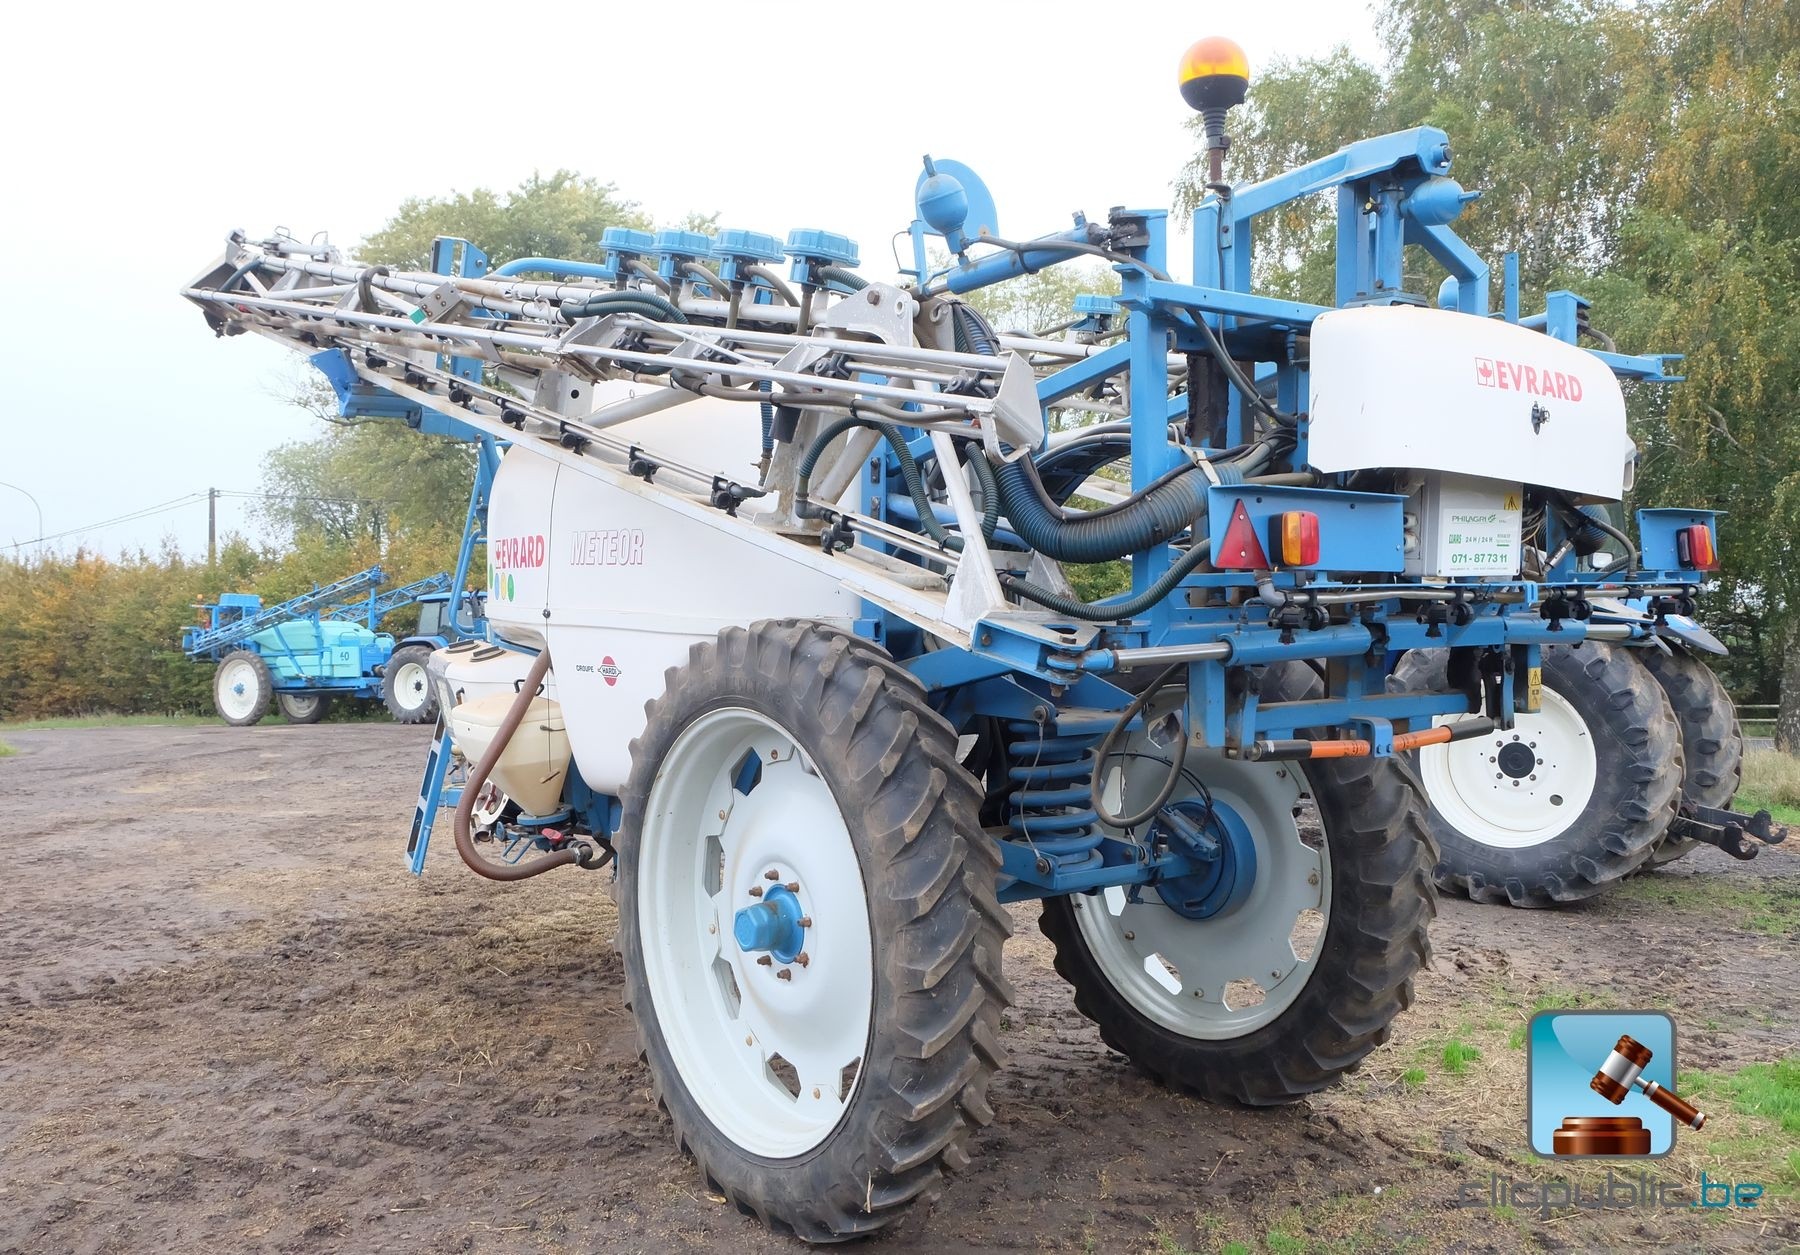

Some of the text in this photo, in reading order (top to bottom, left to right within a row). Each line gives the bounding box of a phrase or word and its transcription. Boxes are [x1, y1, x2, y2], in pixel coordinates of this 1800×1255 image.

[1495, 361, 1583, 402] EVRARD
[1451, 515, 1487, 523] PHILAGRI
[502, 534, 545, 569] EVRARD
[569, 528, 645, 566] METEOR
[575, 664, 617, 675] GROUPE HARDI
